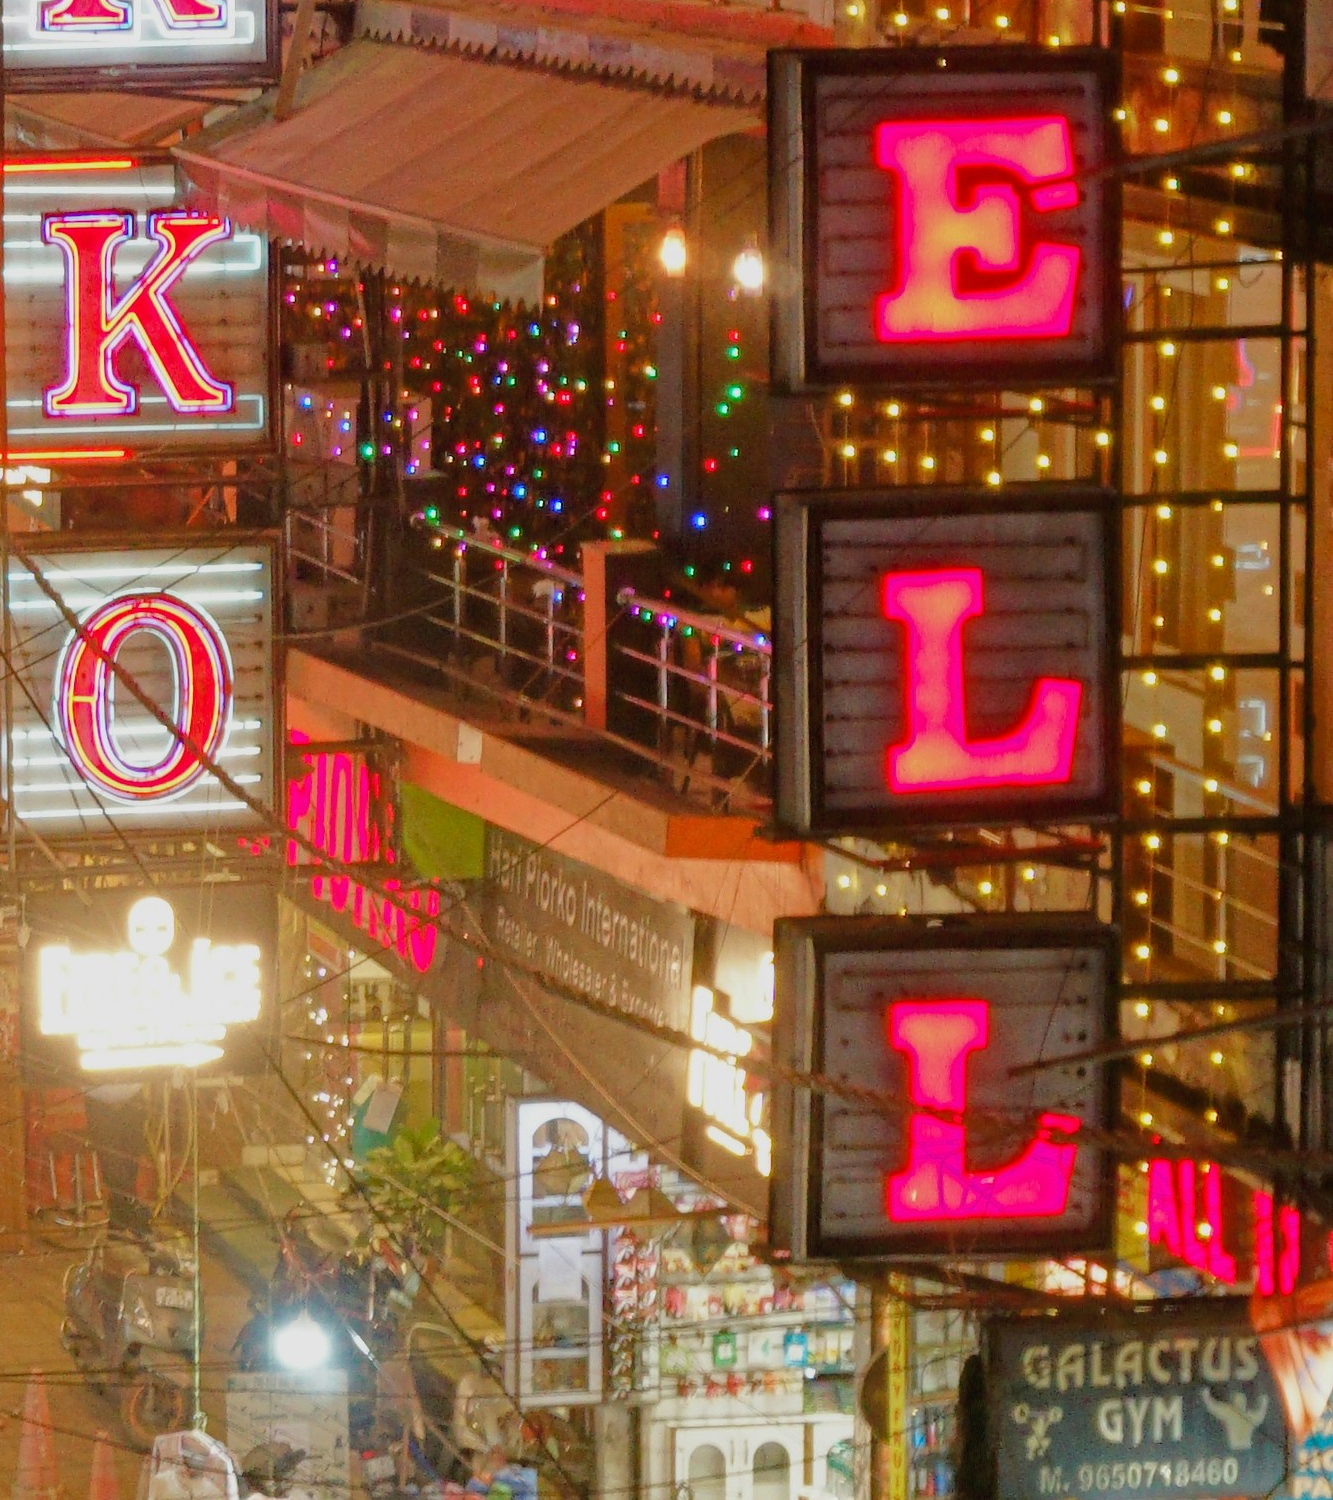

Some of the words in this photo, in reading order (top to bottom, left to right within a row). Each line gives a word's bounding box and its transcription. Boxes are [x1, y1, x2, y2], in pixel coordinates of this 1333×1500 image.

[489, 832, 523, 893] Hari
[526, 853, 577, 928] Piorko
[580, 879, 687, 990] International
[1021, 1336, 1261, 1391] GALACTUS
[1095, 1396, 1184, 1447] GYM
[1039, 1465, 1071, 1495] M.
